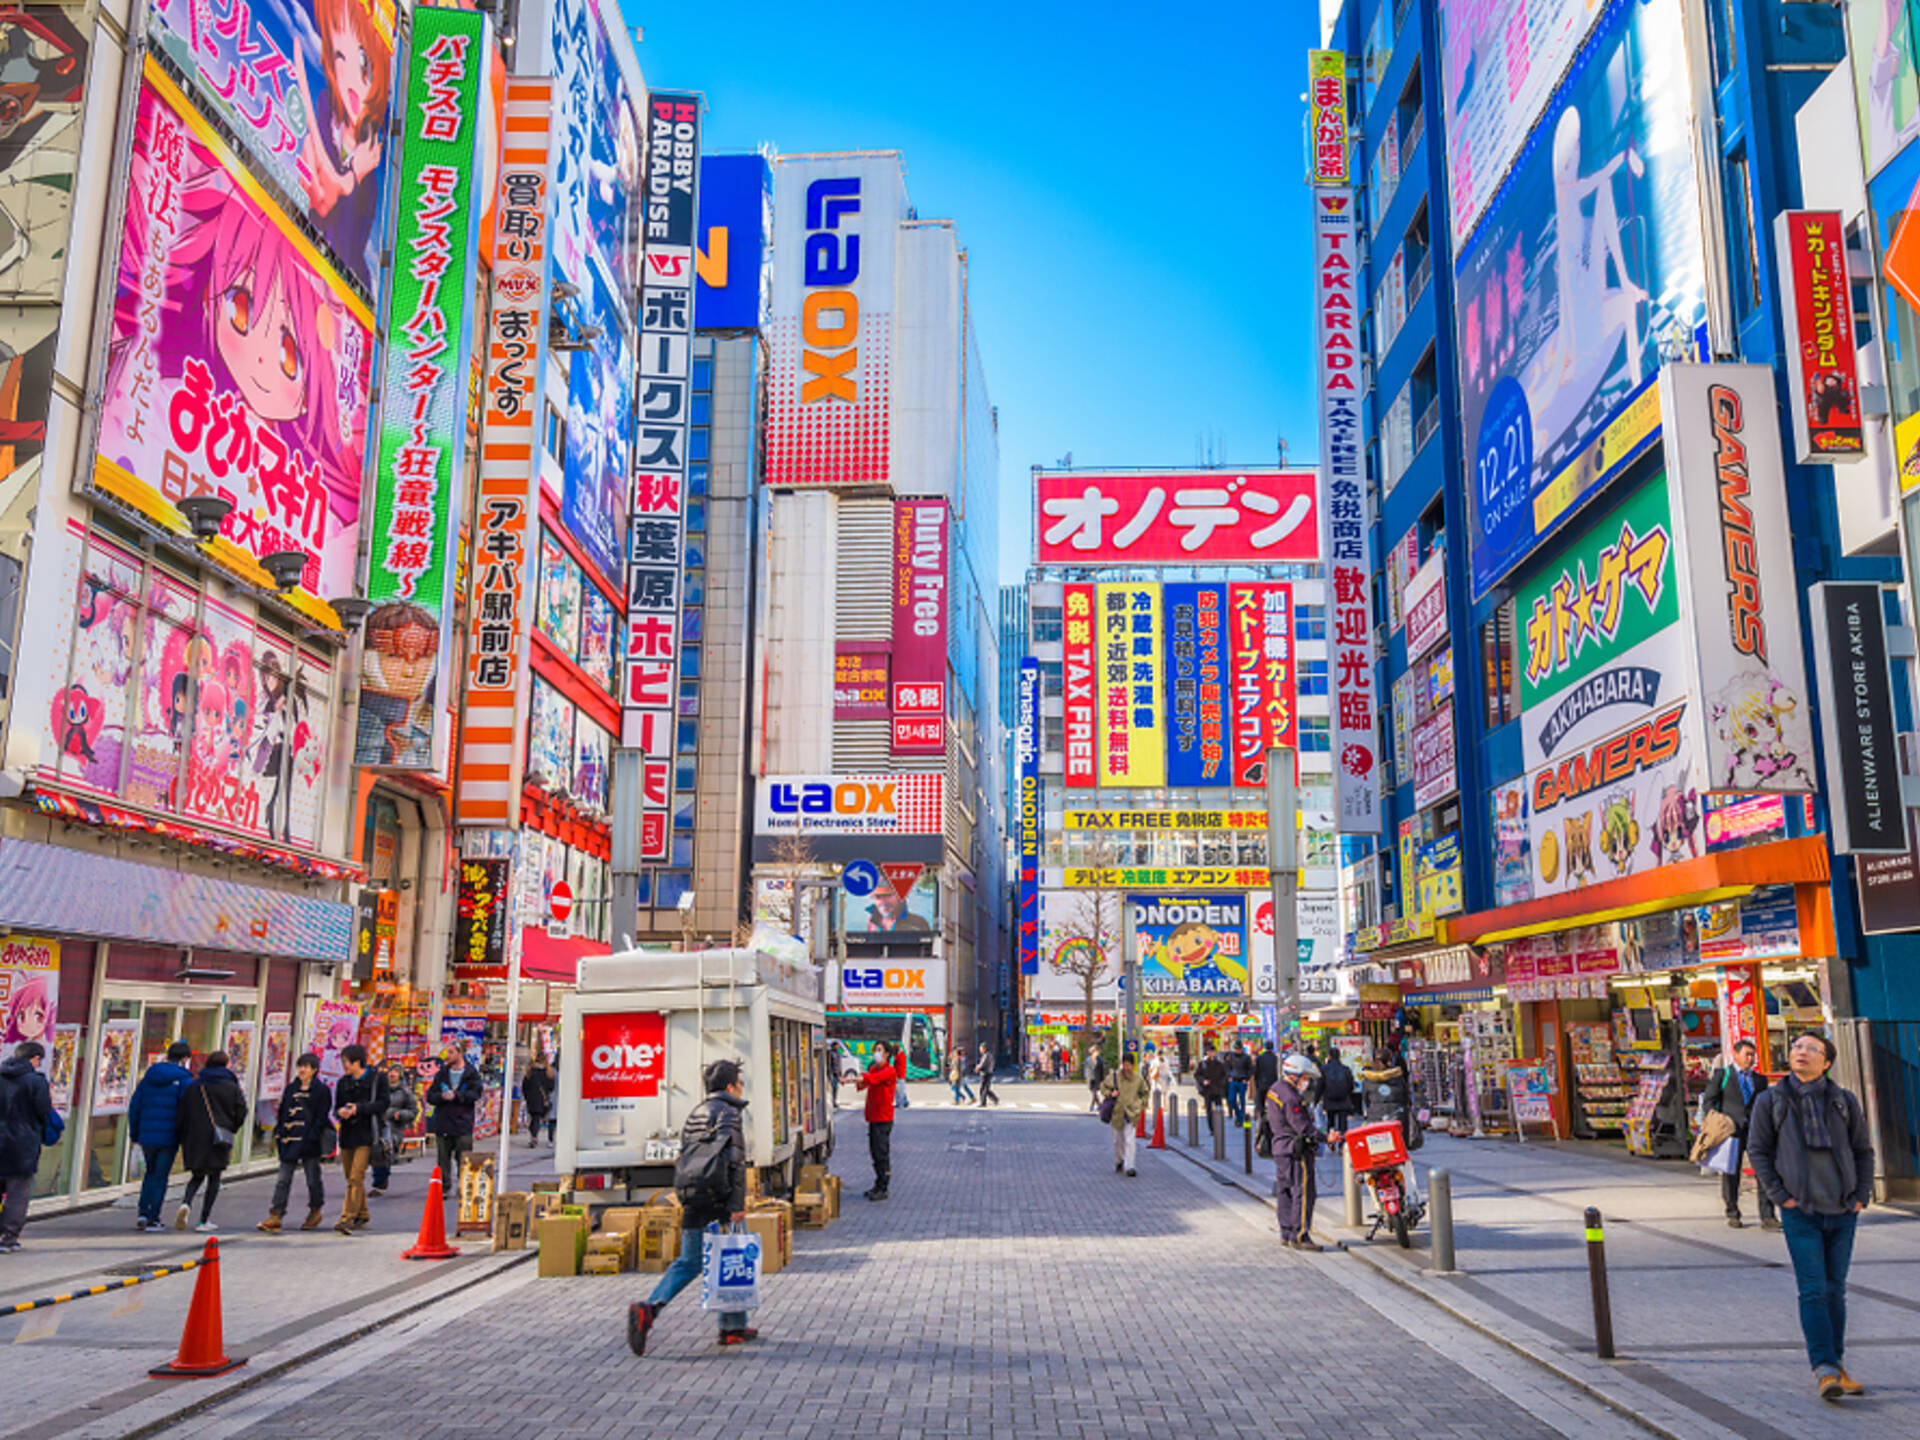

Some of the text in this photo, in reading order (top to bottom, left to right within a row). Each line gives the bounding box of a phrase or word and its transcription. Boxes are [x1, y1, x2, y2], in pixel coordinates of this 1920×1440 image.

[420, 34, 468, 142] パチスロ
[1315, 77, 1344, 178] まんが喫茶
[648, 102, 674, 239] PARADISE
[673, 103, 695, 195] HOBBY
[503, 172, 544, 263] 買取り
[1321, 233, 1355, 390] TAKARADA
[1807, 237, 1838, 367] カードキングダム
[497, 310, 530, 417] まっくす
[1480, 414, 1526, 506] 12.21
[898, 507, 913, 607] Flagship Store
[1043, 476, 1312, 551] オノデン
[1331, 479, 1363, 560] 免税商店
[1708, 383, 1768, 669] GAMERS
[478, 502, 519, 685] アキバ駅前店
[911, 506, 945, 637] Duty Free
[1066, 592, 1092, 775] 免税 TAX FREE
[1333, 565, 1372, 731] 歓迎光臨
[1020, 668, 1037, 764] Panasonic
[1550, 670, 1646, 742] AKIHABARA
[1847, 602, 1883, 832] ALIENWARE STORE AKIBA
[1533, 703, 1687, 814] GAMERS
[803, 817, 863, 828] Electronics
[867, 817, 897, 828] Store
[1022, 776, 1037, 856] ONODEN
[1074, 813, 1113, 827] TAX
[1119, 813, 1171, 827] FREE
[1075, 870, 1116, 884] テレビ
[1173, 871, 1230, 884] エアコン
[1140, 978, 1243, 993] KIHABARA
[1257, 976, 1337, 993] ODEN
